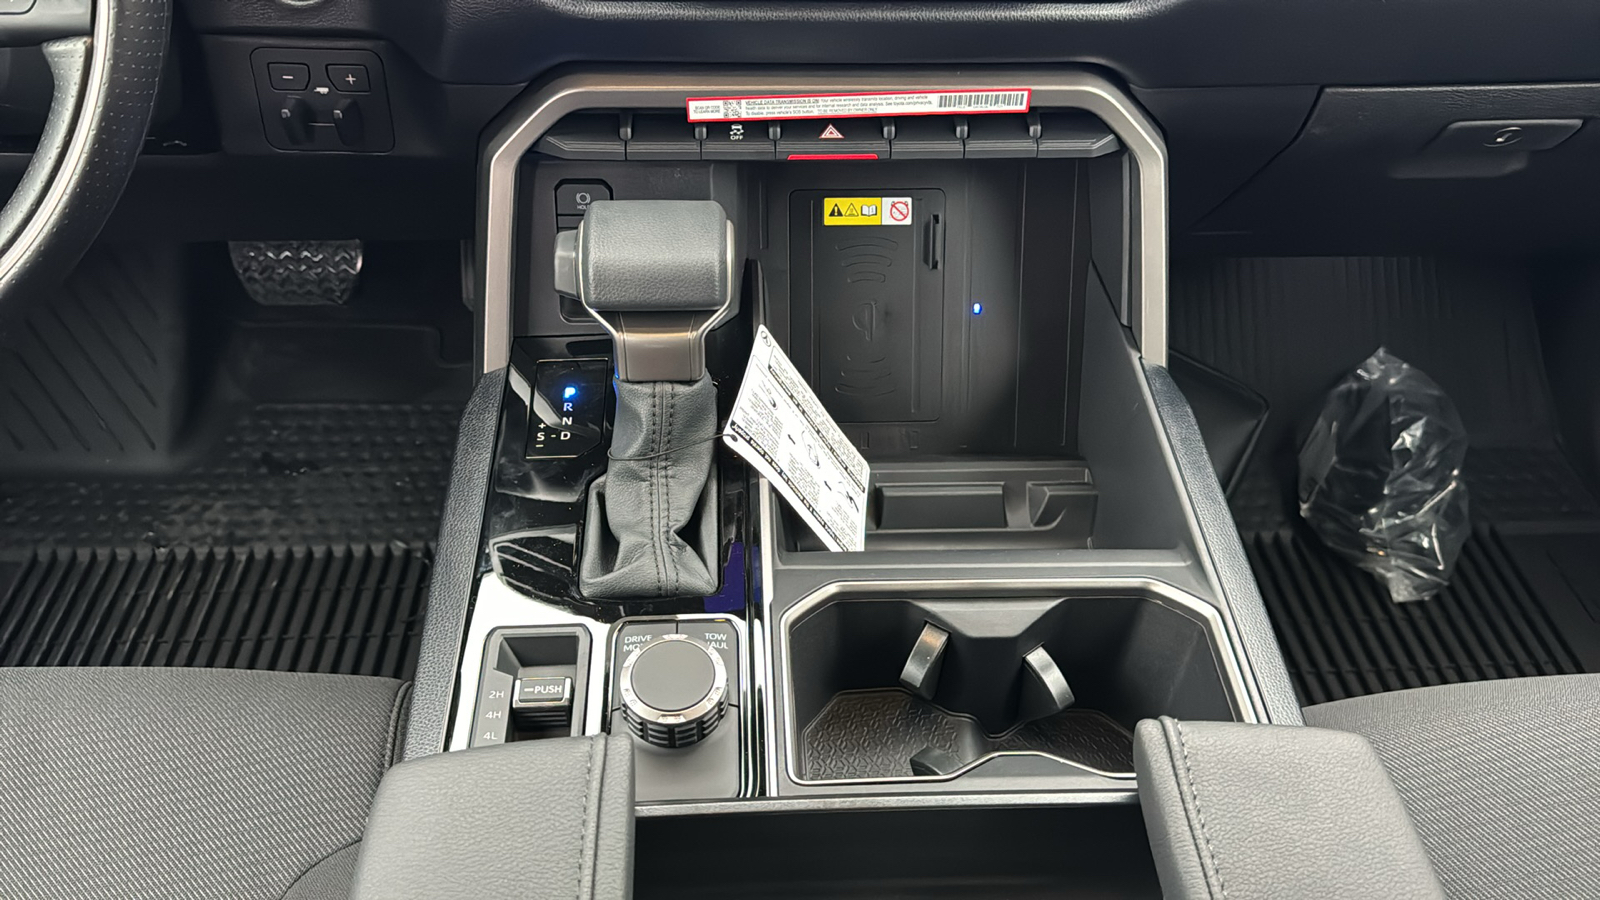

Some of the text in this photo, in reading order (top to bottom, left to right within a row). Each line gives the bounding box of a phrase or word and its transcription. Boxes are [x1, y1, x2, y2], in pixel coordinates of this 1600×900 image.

[564, 386, 576, 398] P
[563, 402, 573, 411] R
[562, 417, 572, 425] N
[536, 432, 570, 441] S D
[624, 635, 652, 643] DRIVE
[624, 644, 643, 652] MO
[534, 685, 562, 694] PUSH
